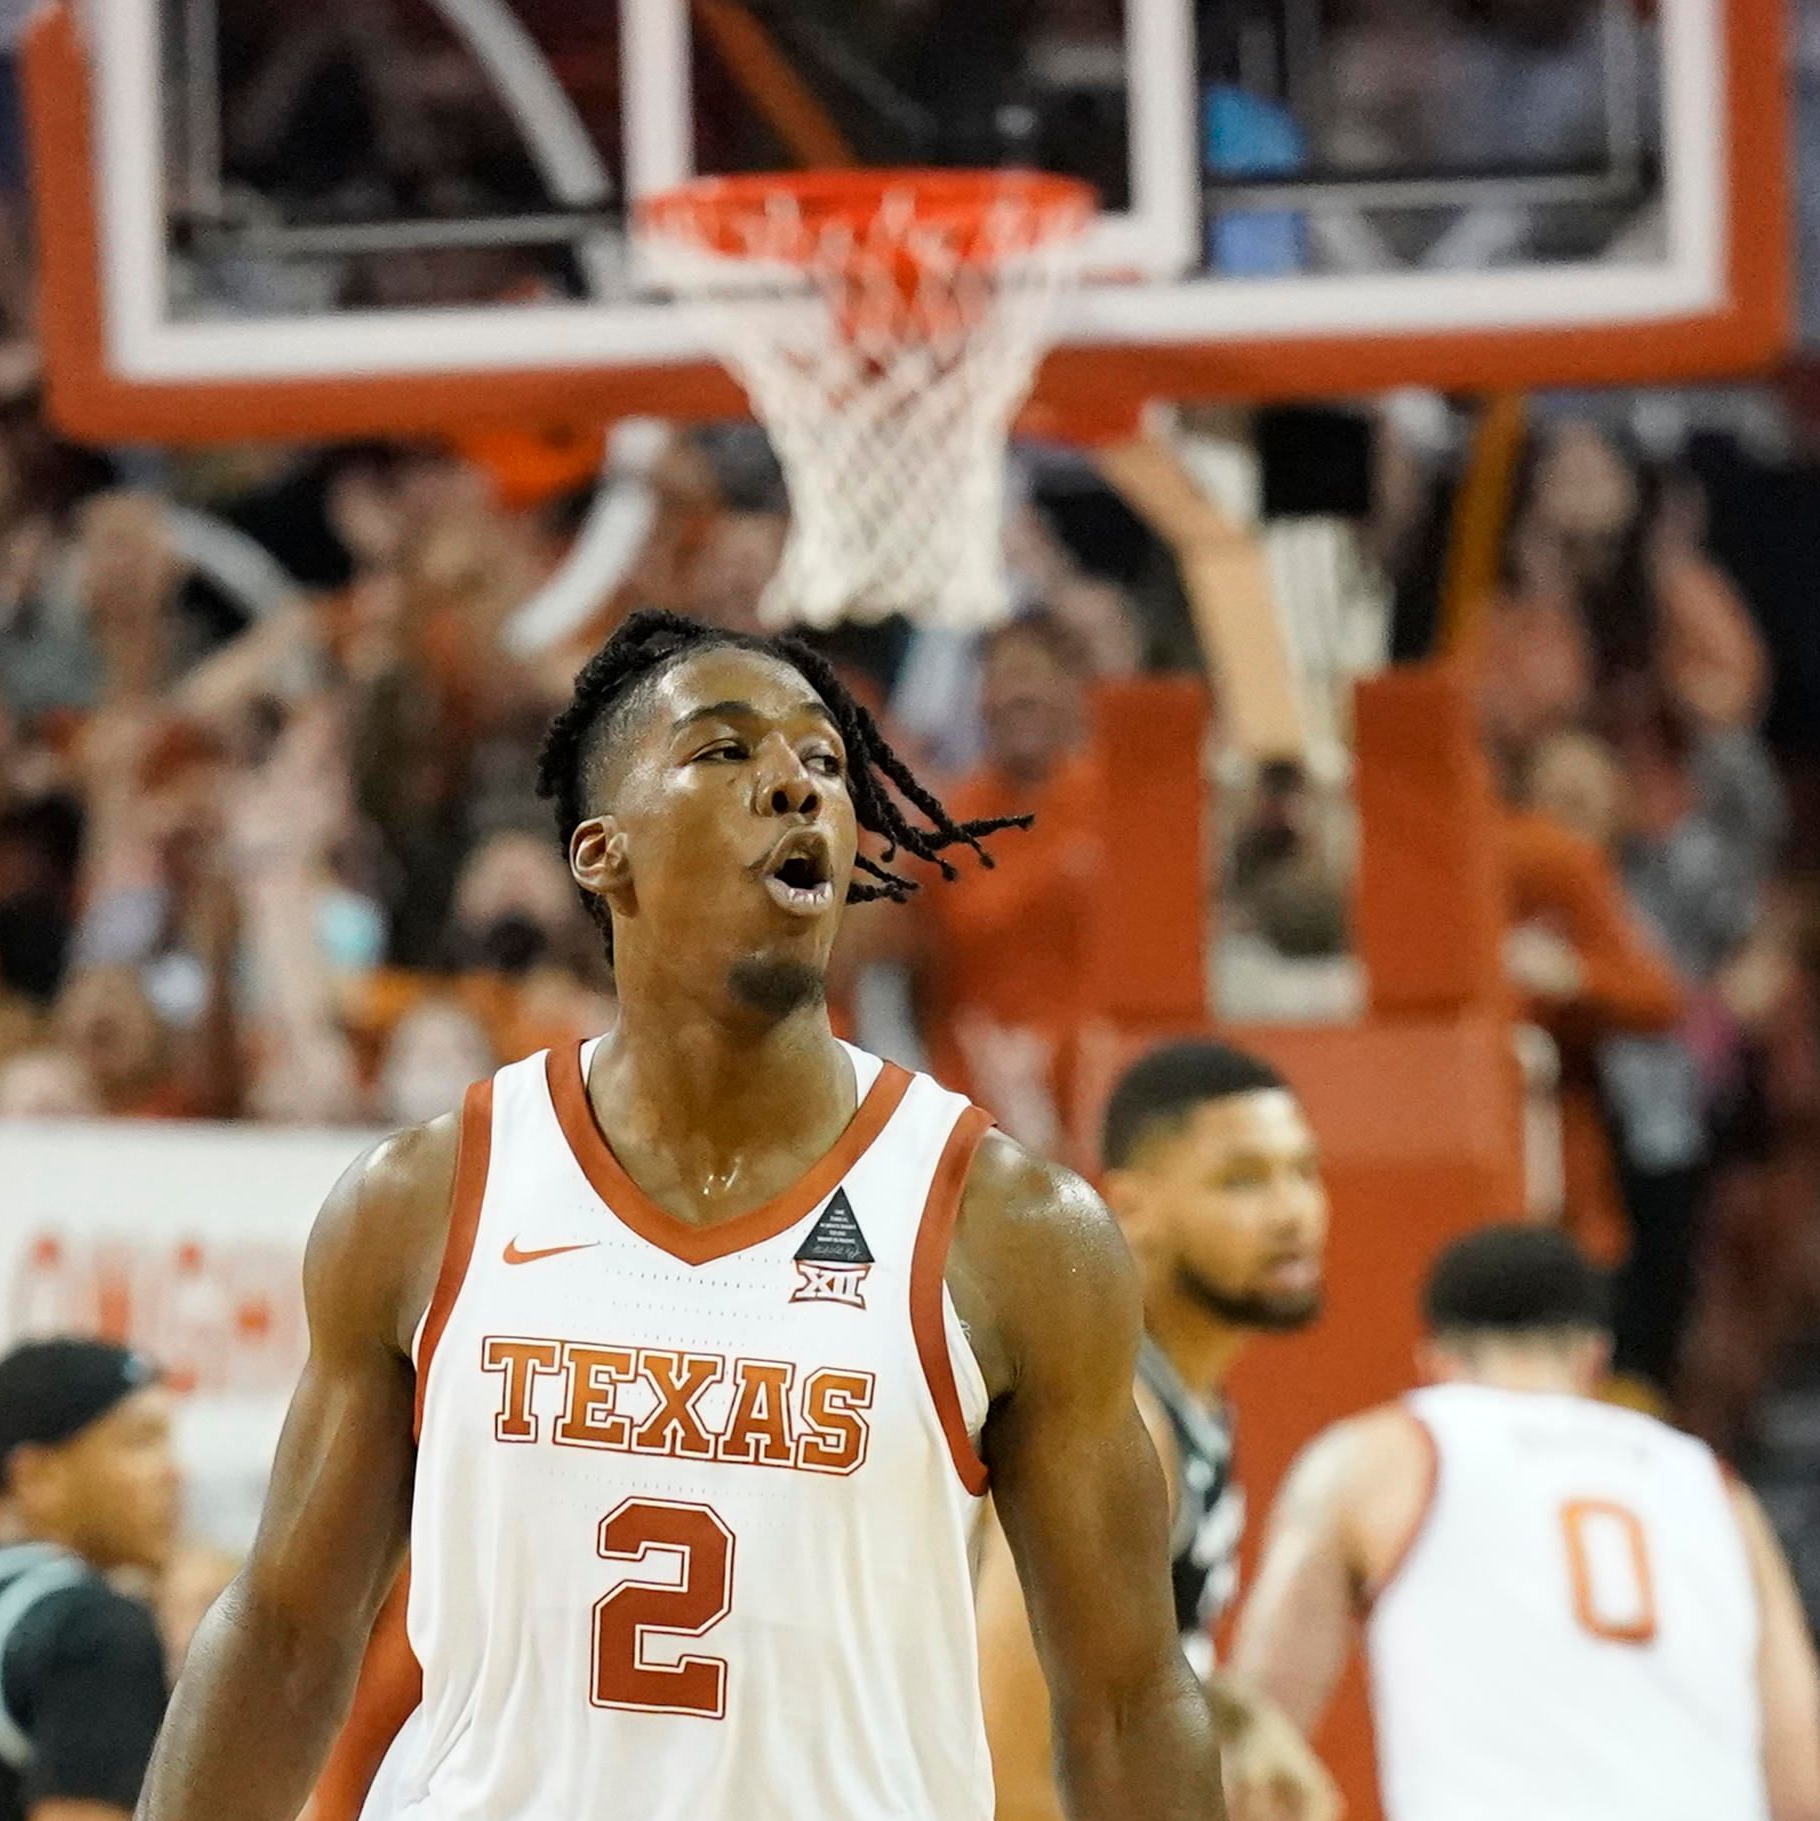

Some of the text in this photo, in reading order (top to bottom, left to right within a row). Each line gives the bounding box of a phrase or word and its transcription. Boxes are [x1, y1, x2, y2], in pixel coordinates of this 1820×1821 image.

[481, 1335, 876, 1477] TEXAS
[590, 1496, 736, 1721] 2
[1559, 1497, 1657, 1650] 0
